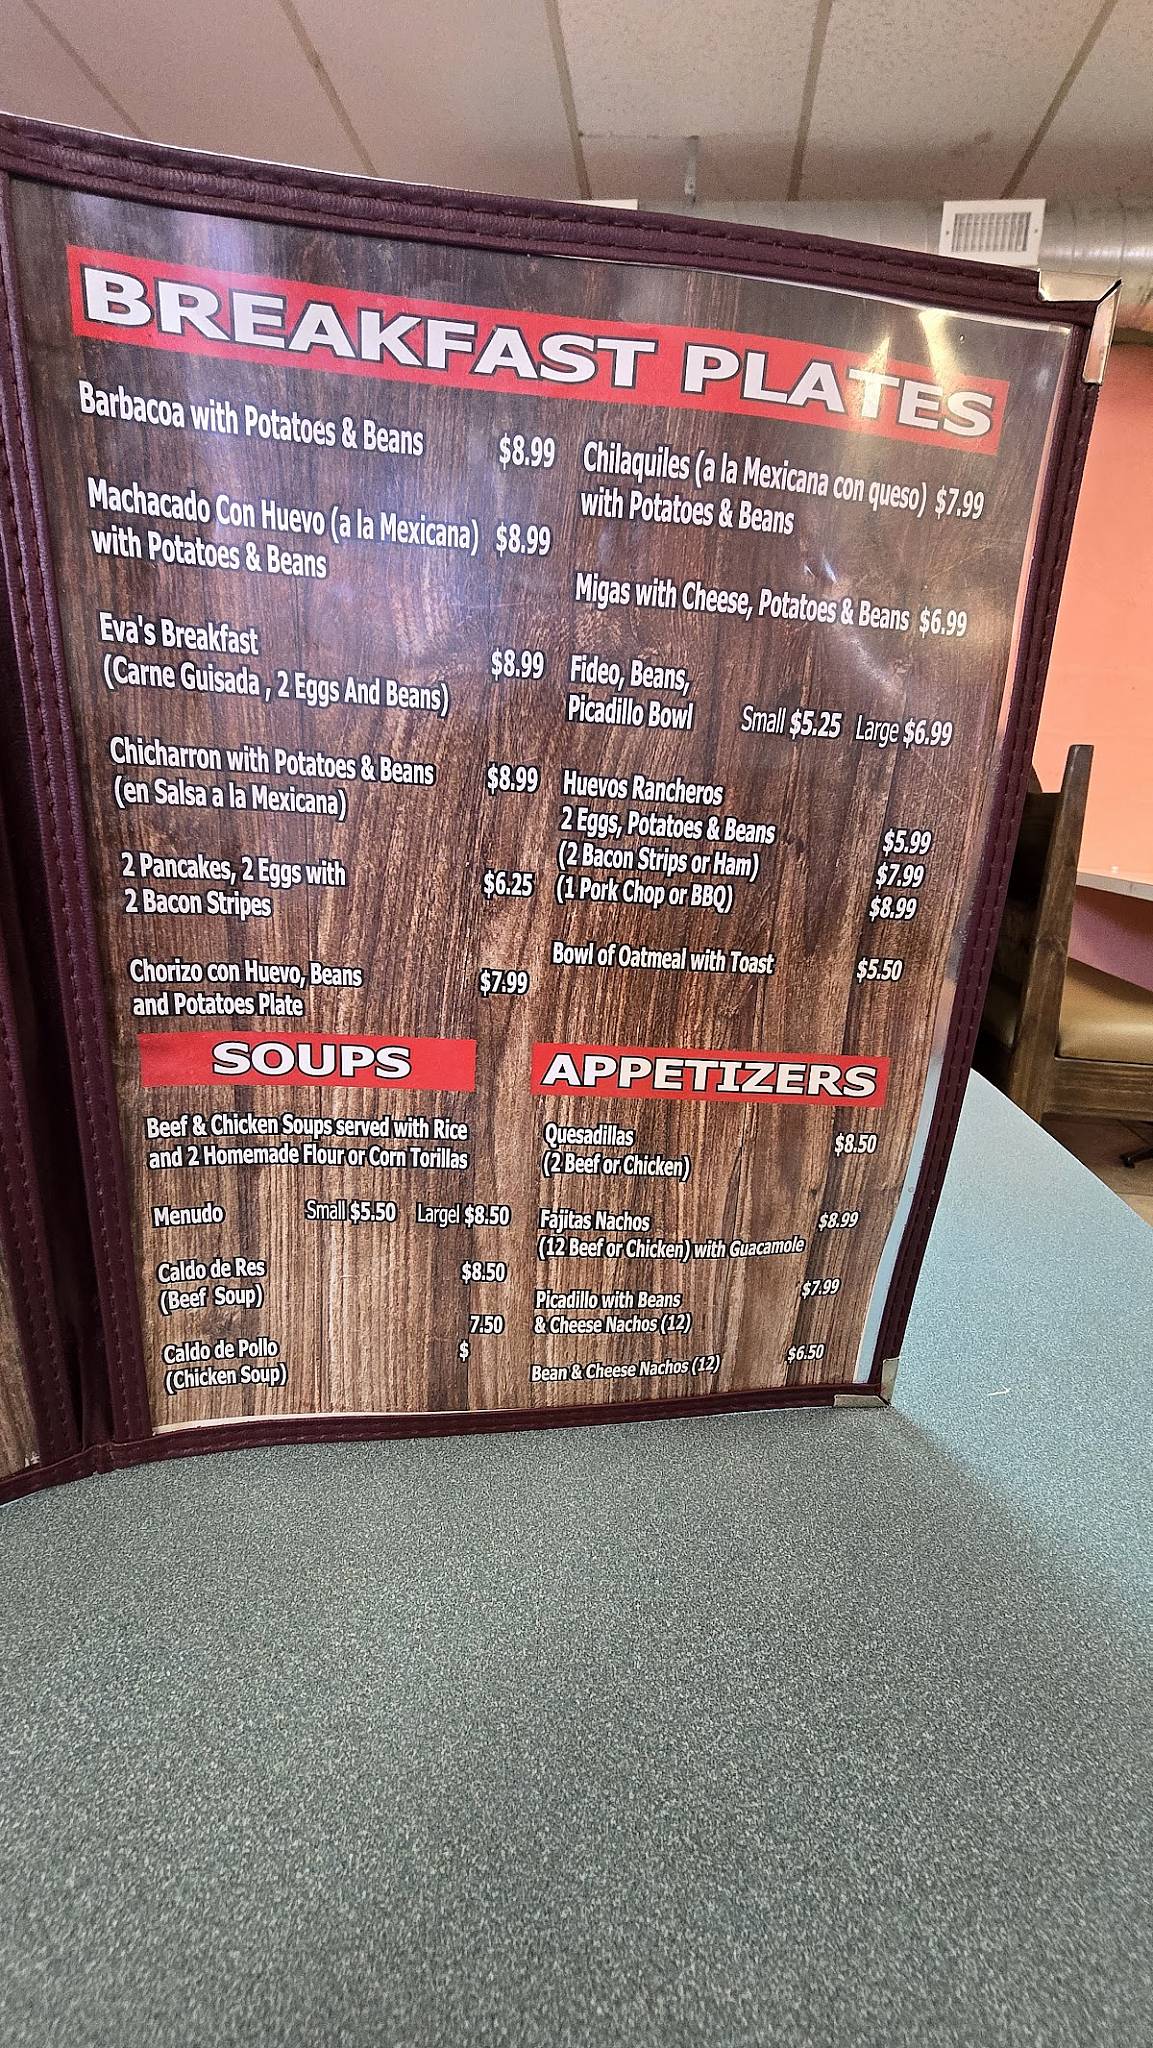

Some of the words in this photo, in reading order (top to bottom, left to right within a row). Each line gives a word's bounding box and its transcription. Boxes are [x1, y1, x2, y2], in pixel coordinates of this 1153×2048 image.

[80, 266, 656, 389] BREAKFAST
[682, 344, 995, 438] PLATES
[78, 379, 185, 429] Barbacoa
[190, 397, 238, 435] with
[244, 410, 336, 448] Potatoes
[363, 421, 424, 456] Beans
[499, 433, 556, 470] $8.99
[583, 441, 690, 484] Chilaquiles
[695, 450, 716, 488] (a
[720, 458, 738, 485] la
[742, 456, 828, 497] Mexicana
[833, 475, 865, 500] con
[867, 481, 928, 518] queso)
[87, 476, 210, 524] Machacado
[215, 494, 256, 529] Con
[261, 500, 326, 537] Huevo
[330, 506, 351, 544] (a
[356, 509, 374, 539] la
[379, 513, 480, 557] Mexicana)
[581, 489, 624, 520] with
[629, 494, 713, 528] Potatoes
[738, 505, 795, 536] Beans
[935, 488, 985, 520] $7.99
[91, 527, 144, 560] with
[148, 534, 240, 569] Potatoes
[267, 546, 328, 579] Beans
[496, 525, 552, 558] $8.99
[575, 573, 631, 611] Migas
[635, 582, 678, 611] with
[681, 581, 753, 622] Cheese,
[757, 589, 837, 624] Potatoes
[858, 599, 910, 632] Beans
[99, 612, 157, 646] Eva's
[160, 619, 260, 656] Breakfast
[919, 605, 968, 638] $6.99
[490, 649, 546, 681] $8.99
[570, 655, 626, 691] Fideo,
[630, 660, 691, 696] Beans,
[103, 653, 176, 690] (Carne
[180, 663, 260, 697] Guisada
[294, 674, 340, 707] Eggs
[344, 675, 381, 706] And
[385, 678, 450, 717] Beans)
[567, 694, 645, 728] Picadillo
[647, 702, 694, 731] Bowl
[740, 705, 786, 735] Small
[789, 710, 843, 739] $5.25
[855, 714, 899, 748] Large
[903, 720, 953, 750] $6.99
[109, 736, 222, 771] Chicharron
[226, 746, 270, 775] with
[274, 749, 357, 781] Potatoes
[379, 757, 435, 786] Beans
[486, 763, 539, 794] $8.99
[562, 769, 628, 800] Huevos
[631, 775, 724, 806] Rancheros
[114, 775, 150, 810] (en
[154, 778, 208, 808] Salsa
[229, 781, 247, 810] la
[251, 784, 348, 821] Mexicana)
[576, 809, 623, 841] Eggs,
[626, 814, 704, 842] Potatoes
[723, 817, 776, 845] Beans
[882, 828, 933, 857] $5.99
[140, 854, 237, 886] Pancakes,
[258, 856, 303, 889] Eggs
[306, 860, 347, 887] with
[557, 840, 578, 871] (2
[581, 843, 634, 870] Bacon
[637, 846, 688, 878] Strips
[713, 852, 760, 882] Ham)
[482, 870, 535, 898] $6.25
[876, 863, 926, 891] $7.99
[142, 888, 203, 916] Bacon
[206, 890, 273, 920] Stripes
[556, 874, 576, 905] (1
[579, 877, 619, 904] Pork
[622, 880, 666, 911] Chop
[690, 883, 734, 914] BBQ)
[869, 896, 917, 922] $8.99
[129, 958, 203, 985] Chorizo
[207, 966, 241, 984] con
[244, 960, 307, 988] Huevo,
[309, 962, 363, 988] Beans
[552, 941, 594, 966] Bowl
[597, 943, 616, 968] of
[618, 945, 687, 970] Oatmeal
[690, 948, 727, 972] with
[729, 950, 775, 975] Toast
[856, 958, 903, 984] $5.50
[479, 969, 529, 996] $7.99
[132, 992, 169, 1017] and
[174, 992, 255, 1017] Potatoes
[258, 992, 304, 1017] Plate
[212, 1040, 412, 1080] SOUPS
[540, 1052, 878, 1098] APPETIZERS
[146, 1115, 189, 1139] Beef
[210, 1113, 279, 1136] Chicken
[282, 1113, 333, 1139] Soups
[336, 1115, 390, 1139] served
[393, 1117, 430, 1140] with
[433, 1118, 468, 1141] Rice
[543, 1122, 635, 1149] Quesadillas
[148, 1145, 183, 1169] and
[203, 1143, 299, 1166] Homemade
[302, 1145, 345, 1166] Flour
[368, 1147, 406, 1167] Corn
[409, 1147, 468, 1170] Torillas
[834, 1133, 878, 1156] $8.50
[542, 1151, 562, 1179] (2
[564, 1155, 600, 1174] Beef
[623, 1155, 692, 1181] Chicken)
[152, 1202, 225, 1228] Menudo
[304, 1200, 346, 1221] Small
[349, 1201, 398, 1225] $5.50
[416, 1202, 460, 1228] Largel
[463, 1205, 511, 1229] $8.50
[539, 1208, 592, 1235] Fajitas
[595, 1211, 651, 1232] Nachos
[818, 1211, 860, 1231] $8.99
[538, 1235, 567, 1262] (12
[569, 1237, 603, 1258] Beef
[606, 1242, 624, 1258] or
[626, 1238, 692, 1263] Chicken)
[693, 1237, 727, 1259] with
[729, 1235, 805, 1258] Guacamole
[157, 1260, 207, 1284] Caldo
[210, 1259, 232, 1278] de
[234, 1258, 266, 1277] Res
[461, 1262, 507, 1284] $8.50
[159, 1286, 207, 1315] (Beef
[214, 1284, 264, 1310] Soup)
[535, 1290, 599, 1309] Picadillo
[602, 1290, 635, 1309] with
[637, 1290, 682, 1309] Beans
[801, 1278, 841, 1300] $7.99
[469, 1315, 504, 1335] 7.50
[549, 1316, 603, 1334] Cheese
[605, 1315, 658, 1333] Nachos
[660, 1313, 692, 1335] (12)
[163, 1344, 211, 1365] Caldo
[214, 1338, 236, 1361] de
[238, 1338, 279, 1359] Pollo
[787, 1344, 825, 1364] $6.50
[164, 1366, 237, 1395] (Chicken
[240, 1363, 289, 1386] Soup)
[530, 1364, 568, 1383] Bean
[586, 1359, 637, 1379] Cheese
[639, 1360, 689, 1376] Nachos
[691, 1355, 721, 1374] (12)
